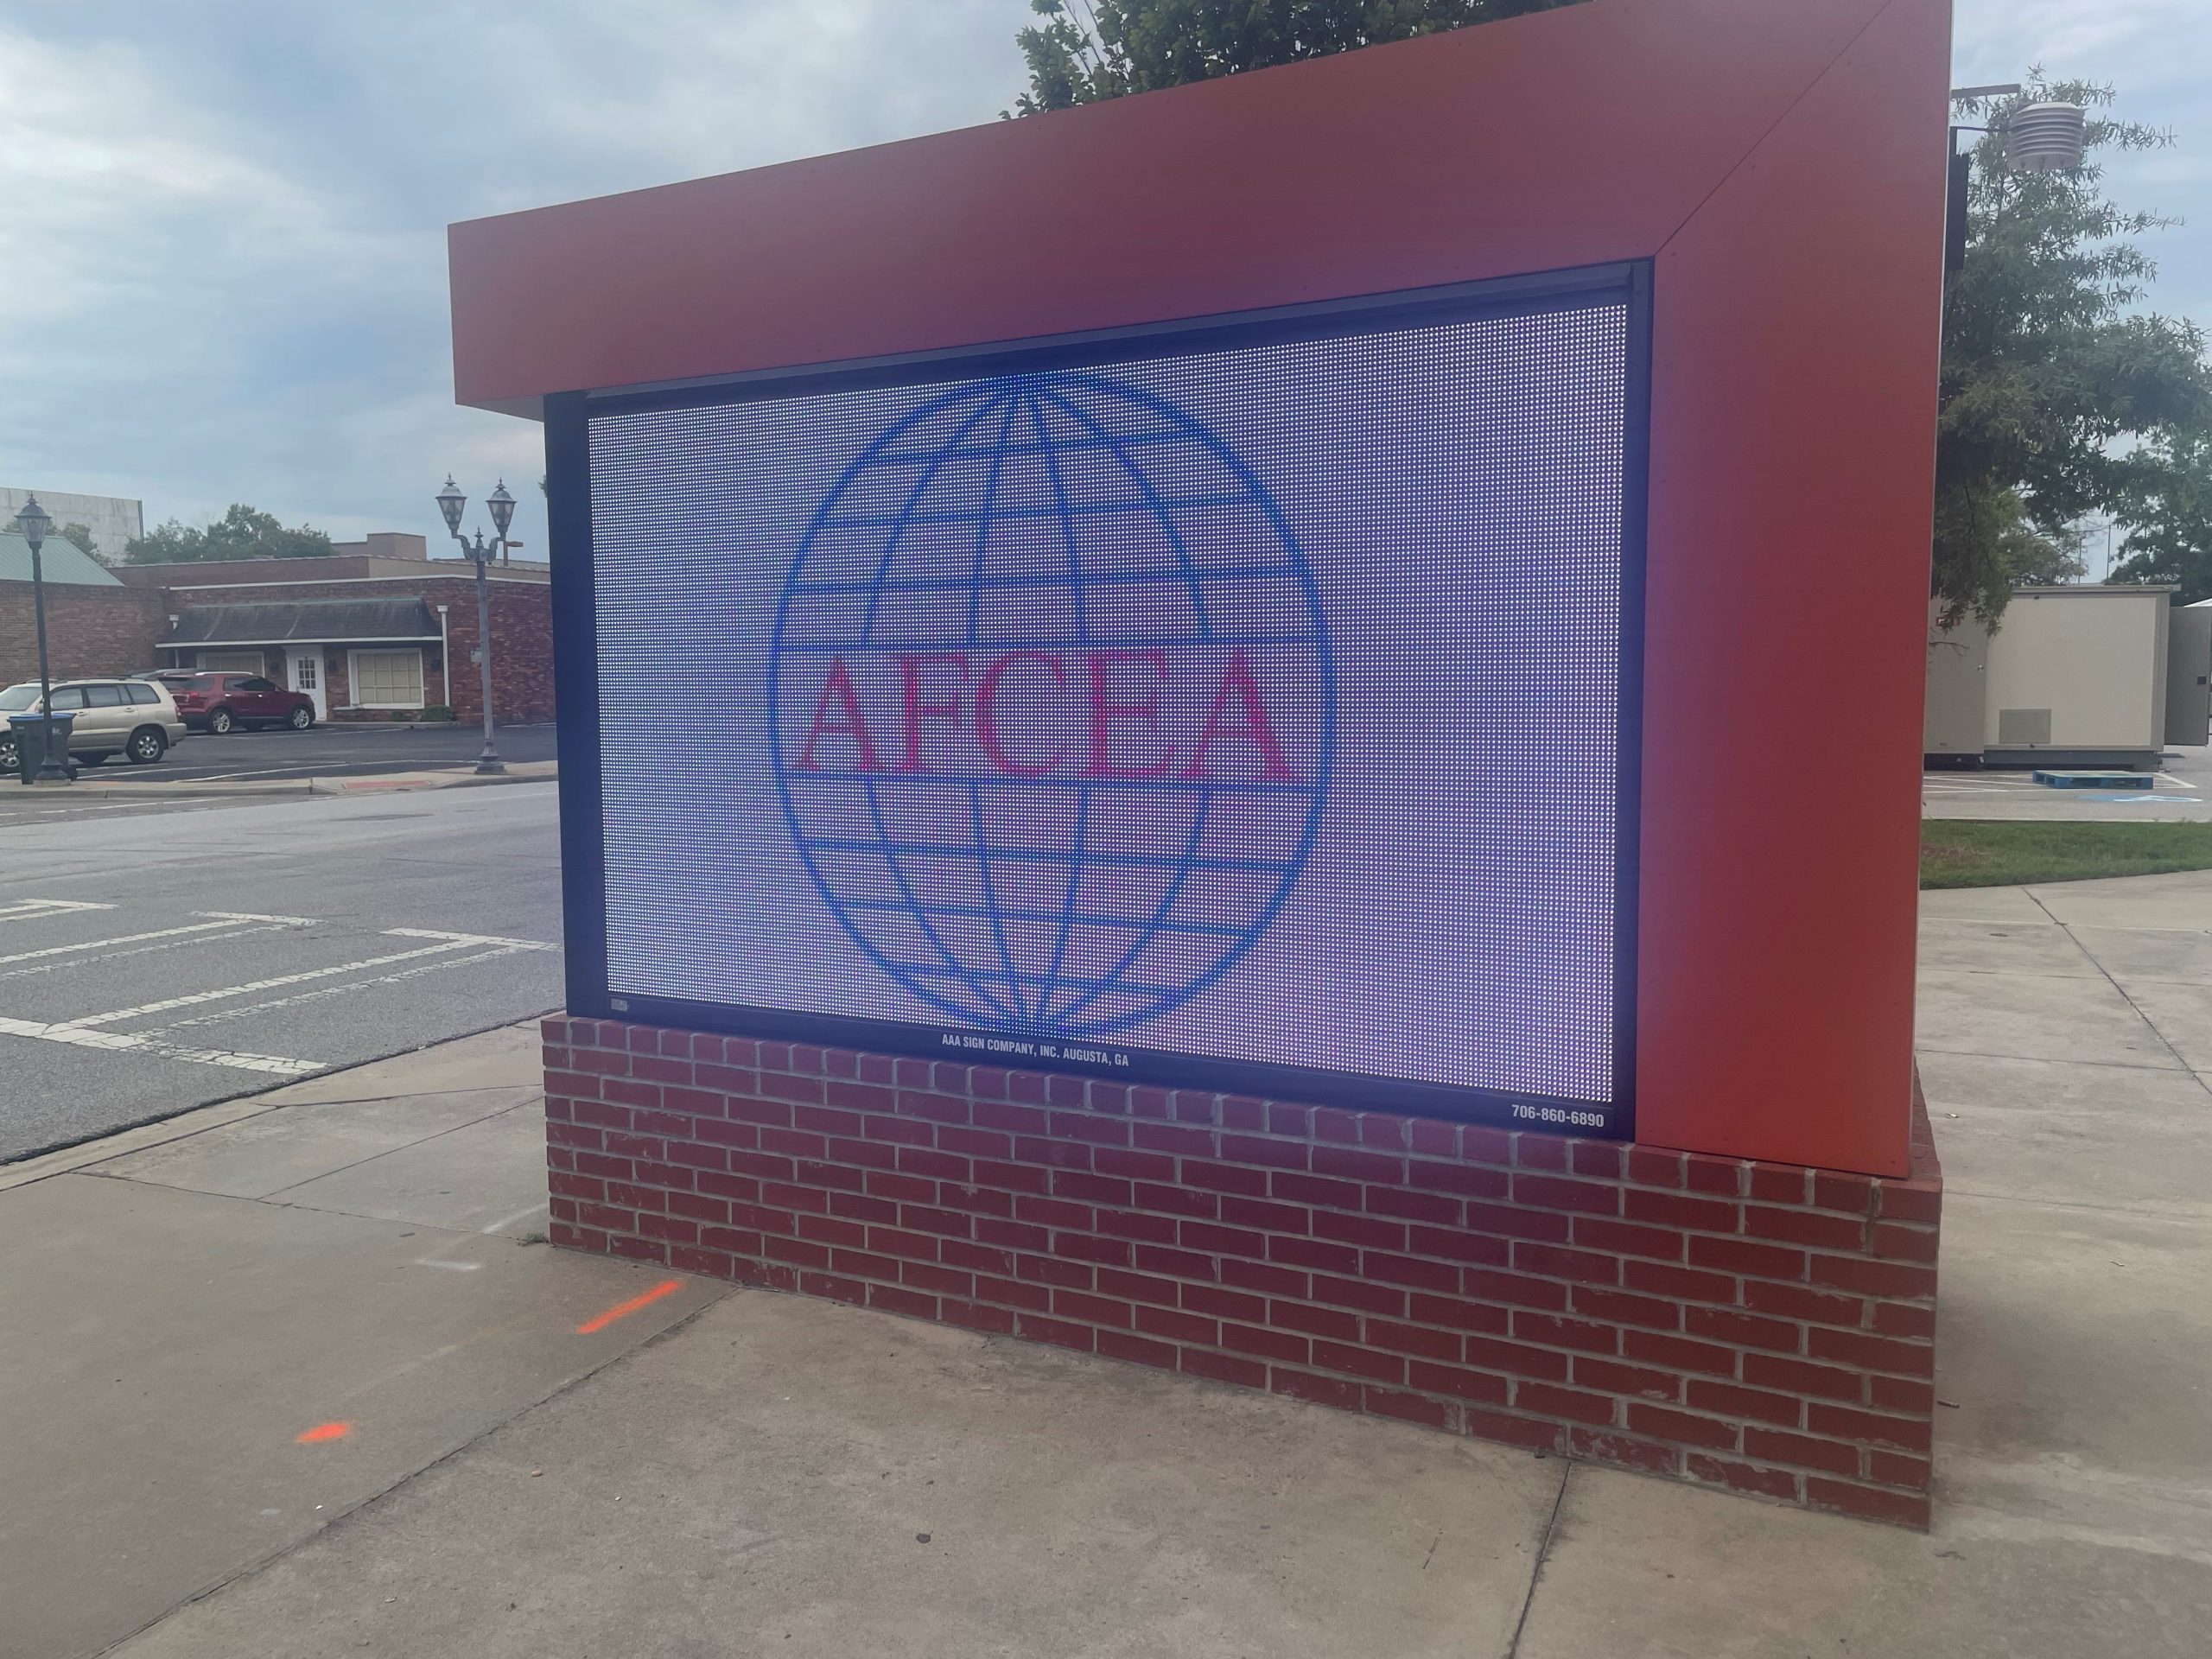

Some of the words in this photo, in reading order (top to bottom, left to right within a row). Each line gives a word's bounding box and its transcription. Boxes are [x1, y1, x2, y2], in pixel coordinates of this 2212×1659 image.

[792, 649, 1297, 781] AFCEA
[942, 1033, 961, 1047] AAA
[963, 1036, 985, 1050] SIGN
[987, 1039, 1037, 1058] COMPANY,
[1039, 1045, 1060, 1058] INC.
[1063, 1047, 1112, 1066] AUGUSTA,
[1114, 1053, 1129, 1067] GA
[1511, 1103, 1605, 1128] 706-860-6890
